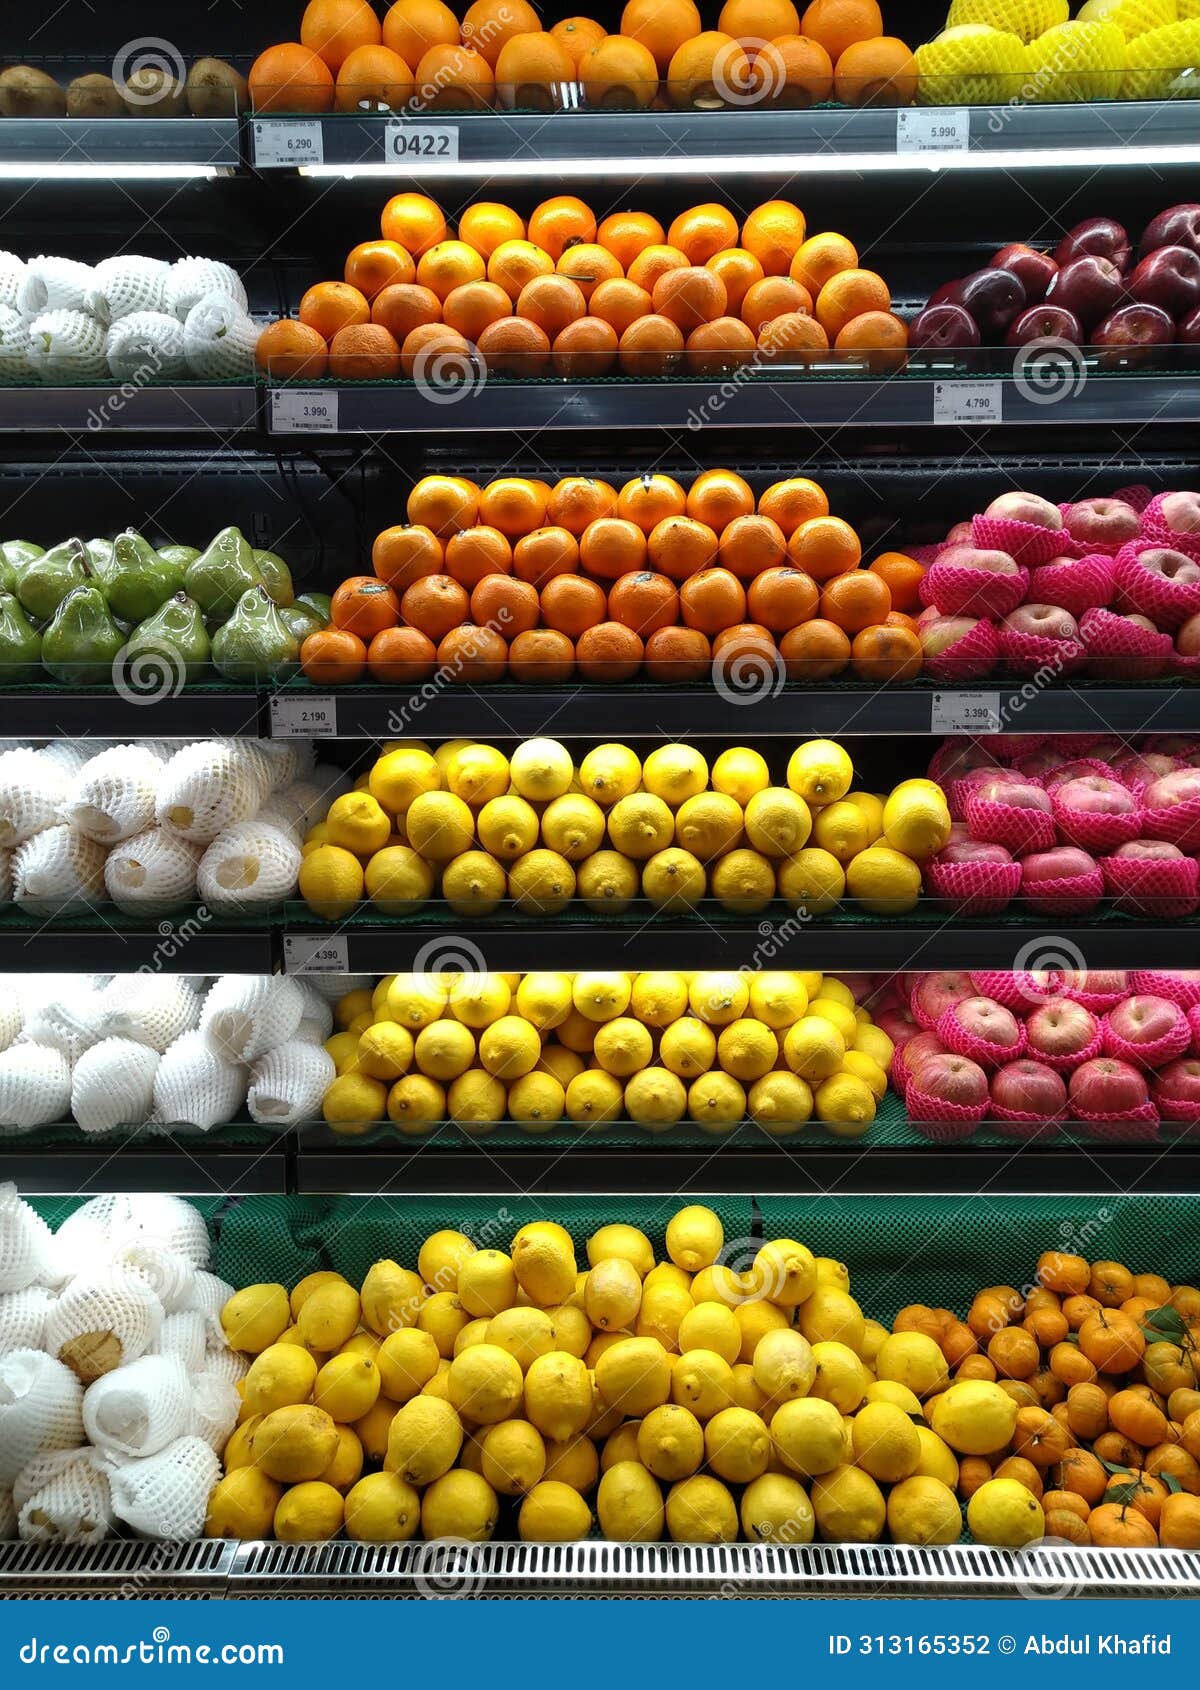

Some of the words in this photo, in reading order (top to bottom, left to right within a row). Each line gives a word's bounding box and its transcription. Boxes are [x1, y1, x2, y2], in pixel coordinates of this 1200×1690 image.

[931, 126, 956, 137] 5.990
[393, 134, 450, 155] 0422
[303, 406, 327, 417] 3.990
